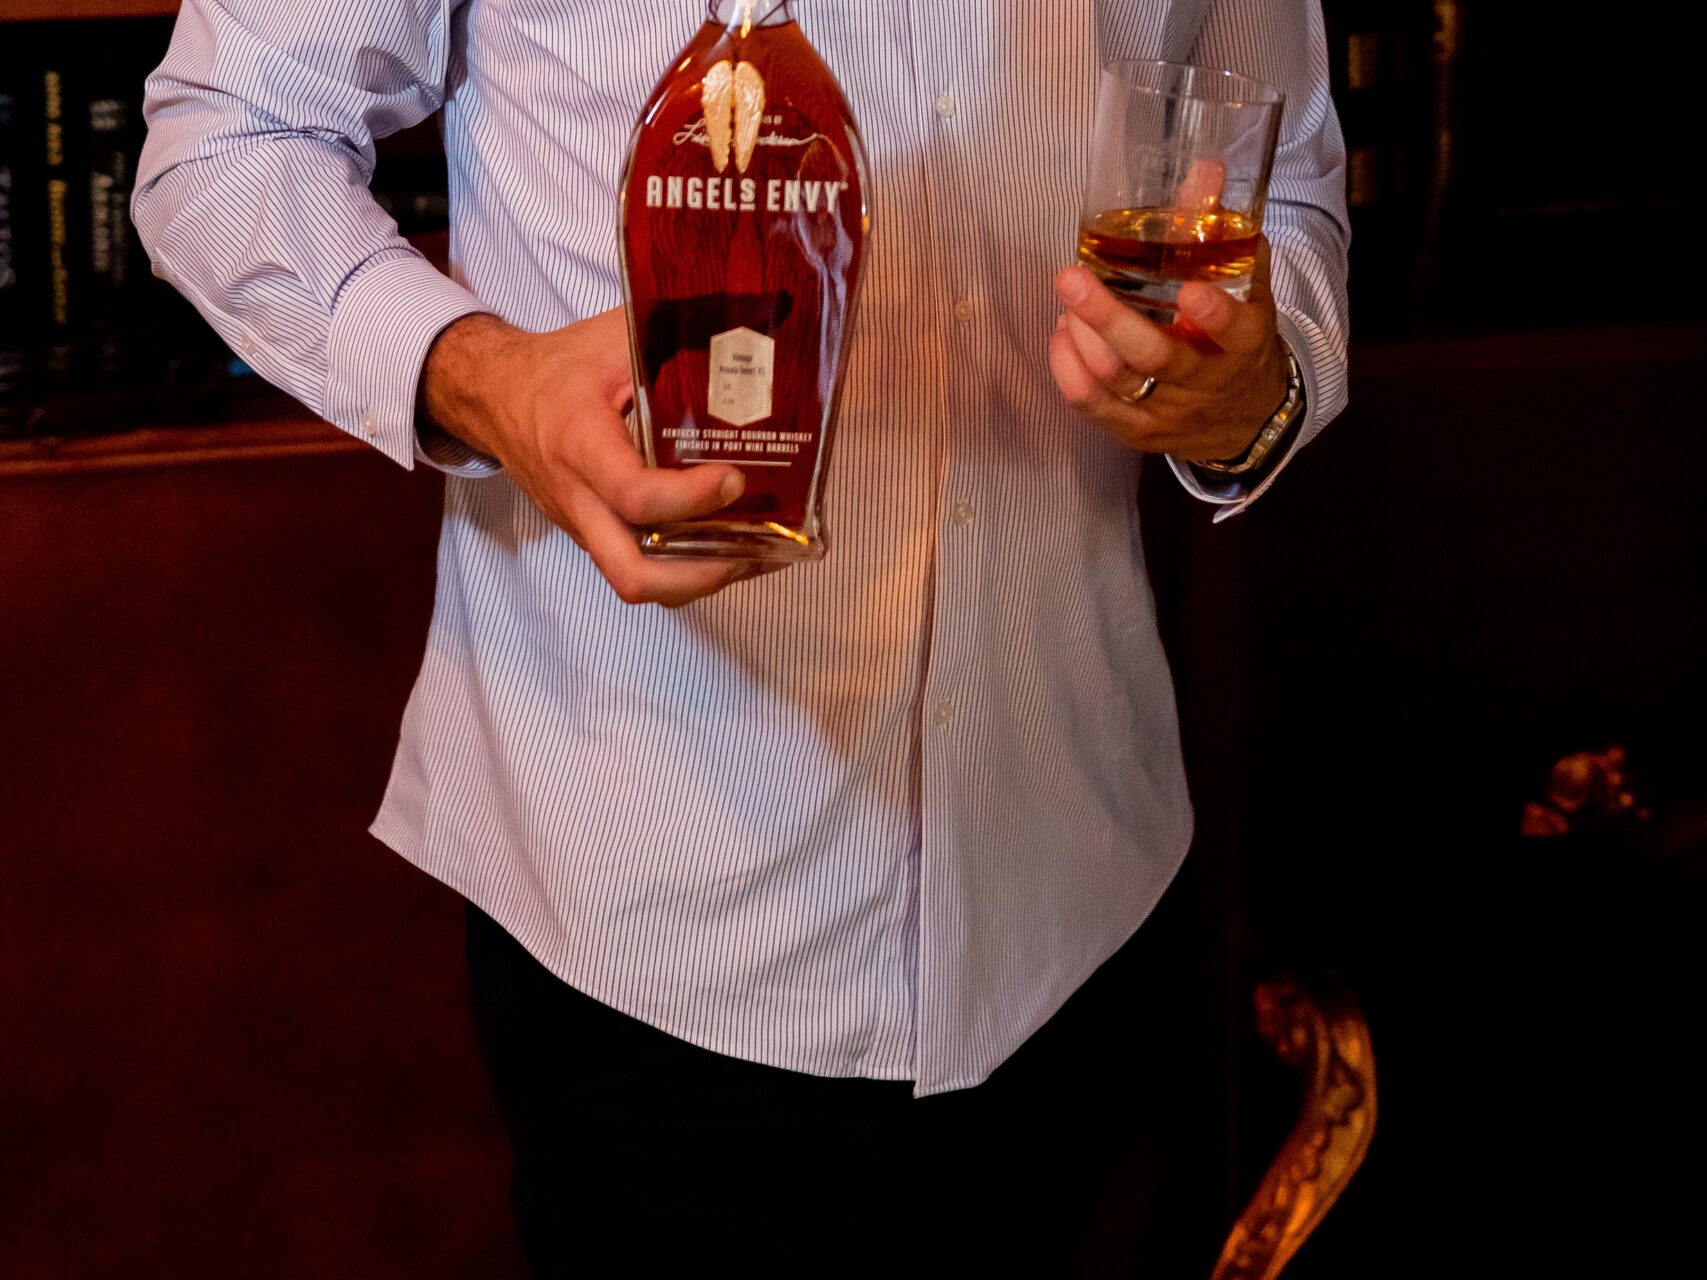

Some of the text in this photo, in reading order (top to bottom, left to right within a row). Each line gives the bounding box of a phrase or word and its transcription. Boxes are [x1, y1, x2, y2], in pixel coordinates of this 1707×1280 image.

[766, 179, 841, 213] ENVY
[662, 428, 813, 443] KENTUCKY STRAIGHT BOURBON WHISKEY
[675, 439, 800, 454] FINISHED IN PORT WINE BARRELS
